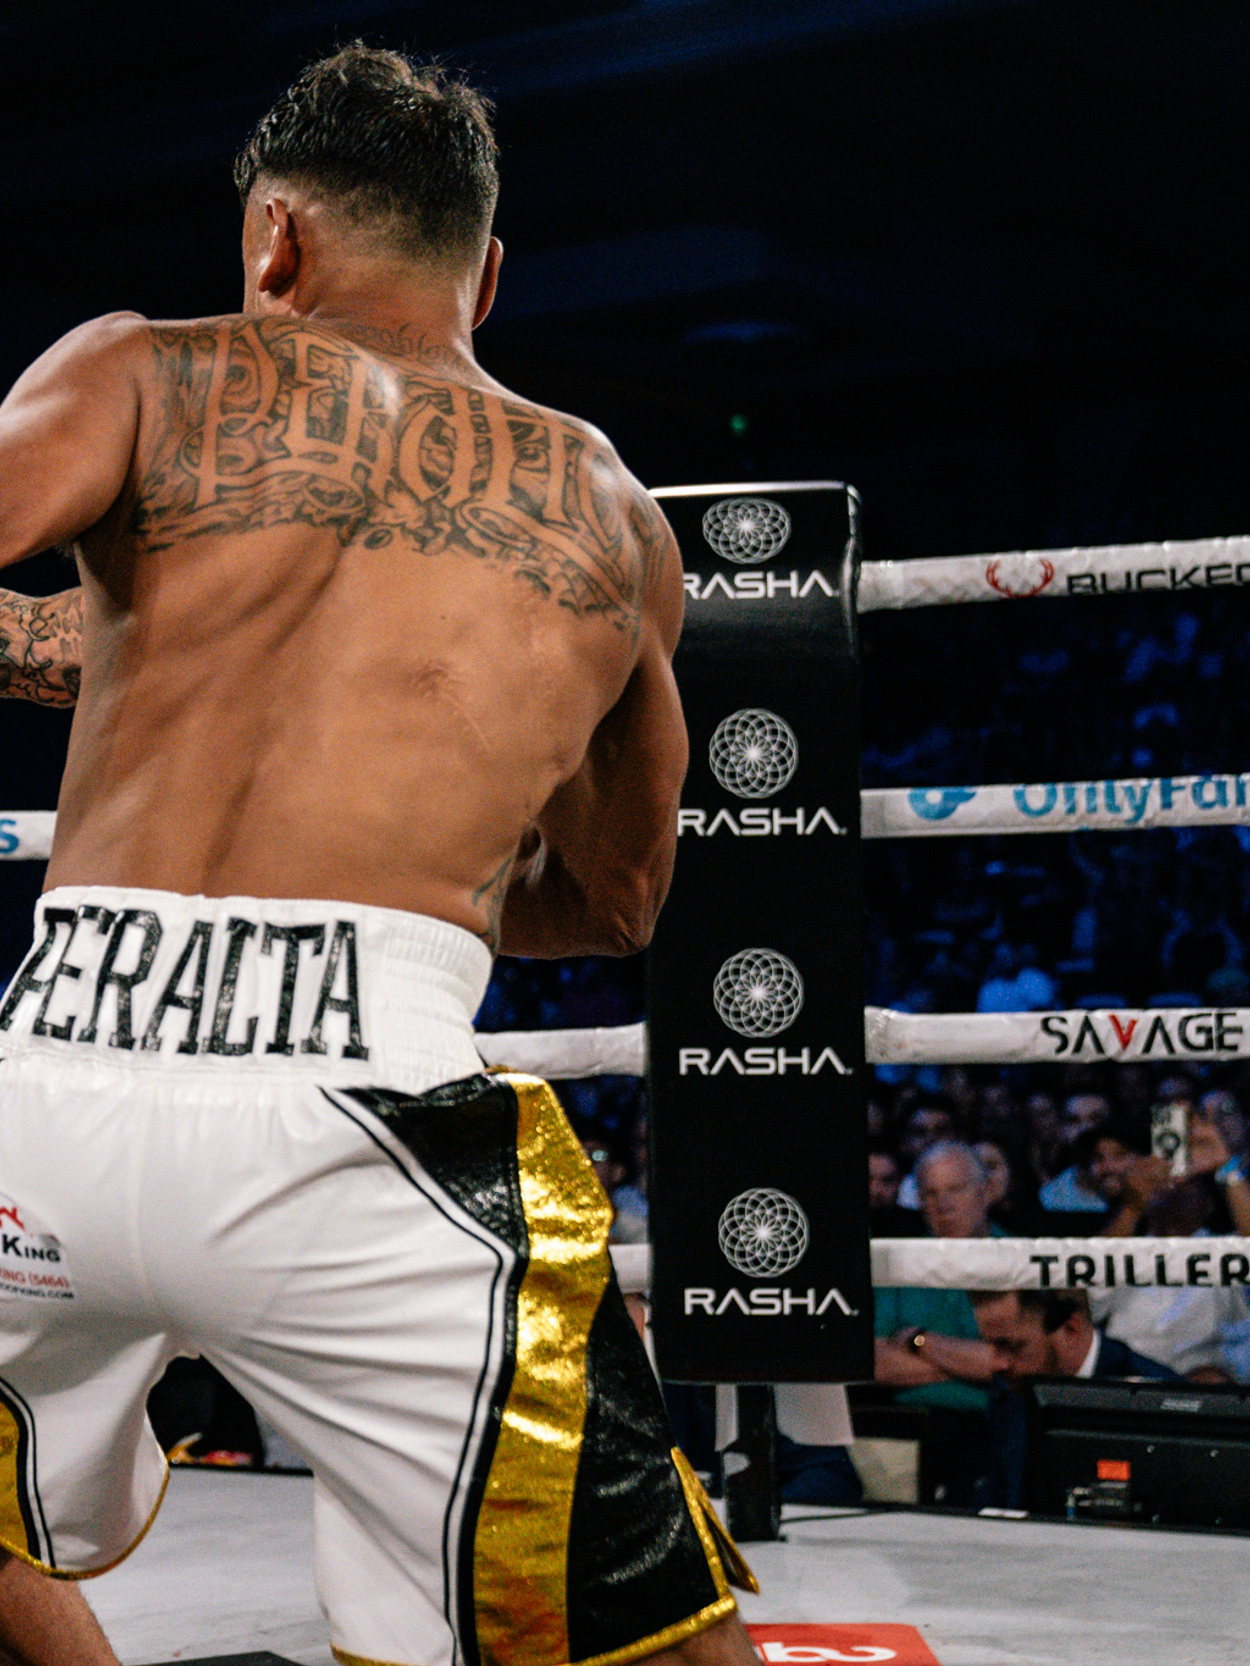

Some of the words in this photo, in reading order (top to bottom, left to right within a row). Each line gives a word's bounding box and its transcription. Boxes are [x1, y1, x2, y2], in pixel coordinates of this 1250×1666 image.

[683, 570, 838, 600] RASHA
[677, 807, 842, 837] RASHA
[1040, 1012, 1243, 1055] SAVAGE
[679, 1047, 851, 1075] RASHA
[2, 1233, 61, 1262] KING
[1030, 1254, 1250, 1287] TRILLER
[684, 1288, 853, 1315] RASHA
